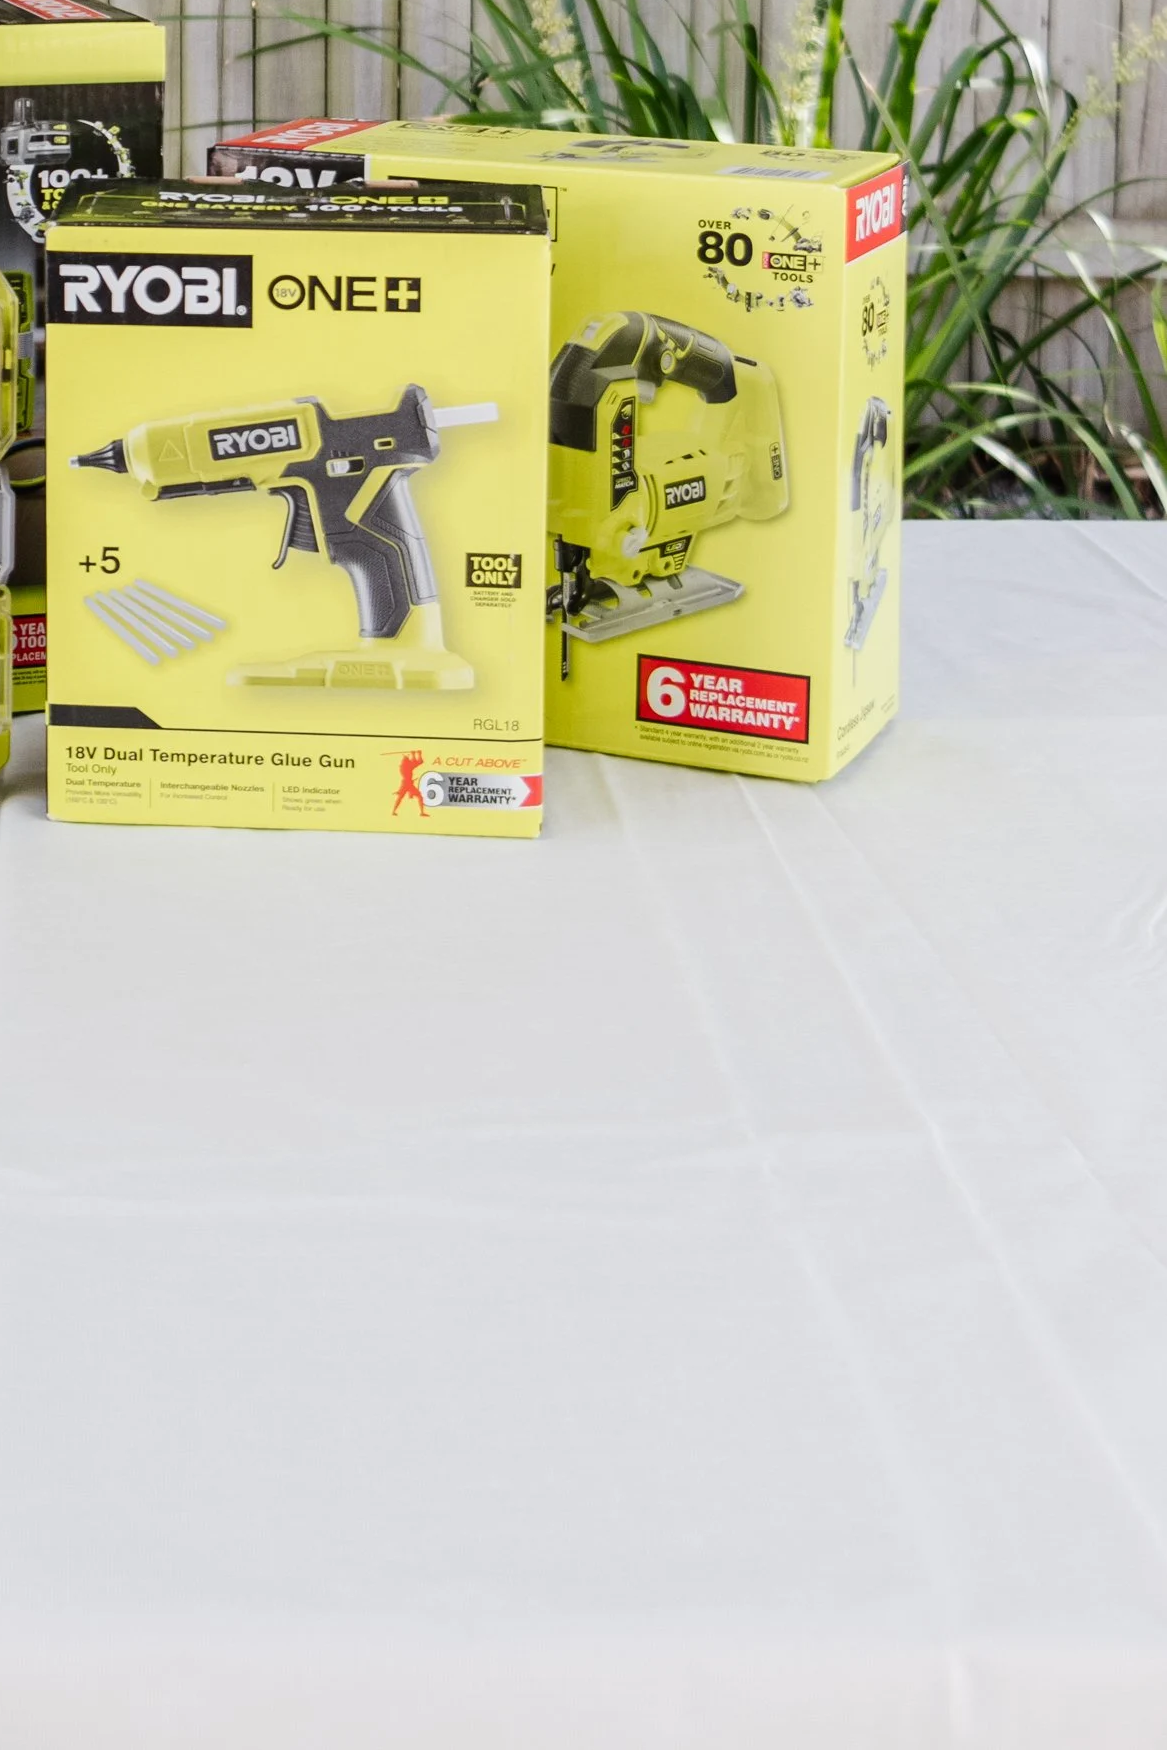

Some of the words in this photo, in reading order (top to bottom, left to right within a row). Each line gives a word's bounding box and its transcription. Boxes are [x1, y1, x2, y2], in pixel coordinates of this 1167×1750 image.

[159, 191, 266, 204] RYOBI
[141, 201, 189, 209] ONE
[305, 204, 385, 212] 100+
[855, 183, 896, 243] RYOBI
[698, 219, 731, 230] OVER
[697, 230, 753, 267] 80
[772, 271, 814, 283] TOOLS
[59, 263, 237, 316] RYOBI
[213, 425, 297, 455] RYOBI
[665, 480, 704, 505] RYOBI
[79, 546, 121, 575] +5
[470, 556, 518, 571] TOOL
[471, 570, 517, 585] ONLY
[19, 622, 46, 635] YEA
[19, 635, 46, 648] TOO
[690, 672, 743, 693] YEAR
[647, 666, 685, 718] 6
[689, 689, 798, 715] REPLACEMENT
[473, 718, 520, 732] RGL18
[66, 746, 97, 759] 18V
[104, 747, 143, 761] Dual
[149, 748, 264, 766] Temperature
[271, 752, 312, 767] Glue
[319, 754, 355, 768] Gun
[432, 757, 441, 766] A
[445, 757, 474, 767] CUT
[66, 763, 88, 773] Tool
[92, 764, 117, 776] Only
[66, 778, 85, 786] Dual
[88, 779, 142, 788] Temperature
[160, 782, 229, 791] Interchangeable
[231, 784, 265, 792] Nozzles
[448, 776, 478, 786] YEAR
[302, 787, 340, 795] Indicator
[418, 770, 444, 807] 6
[448, 786, 512, 795] REPLACEMENT
